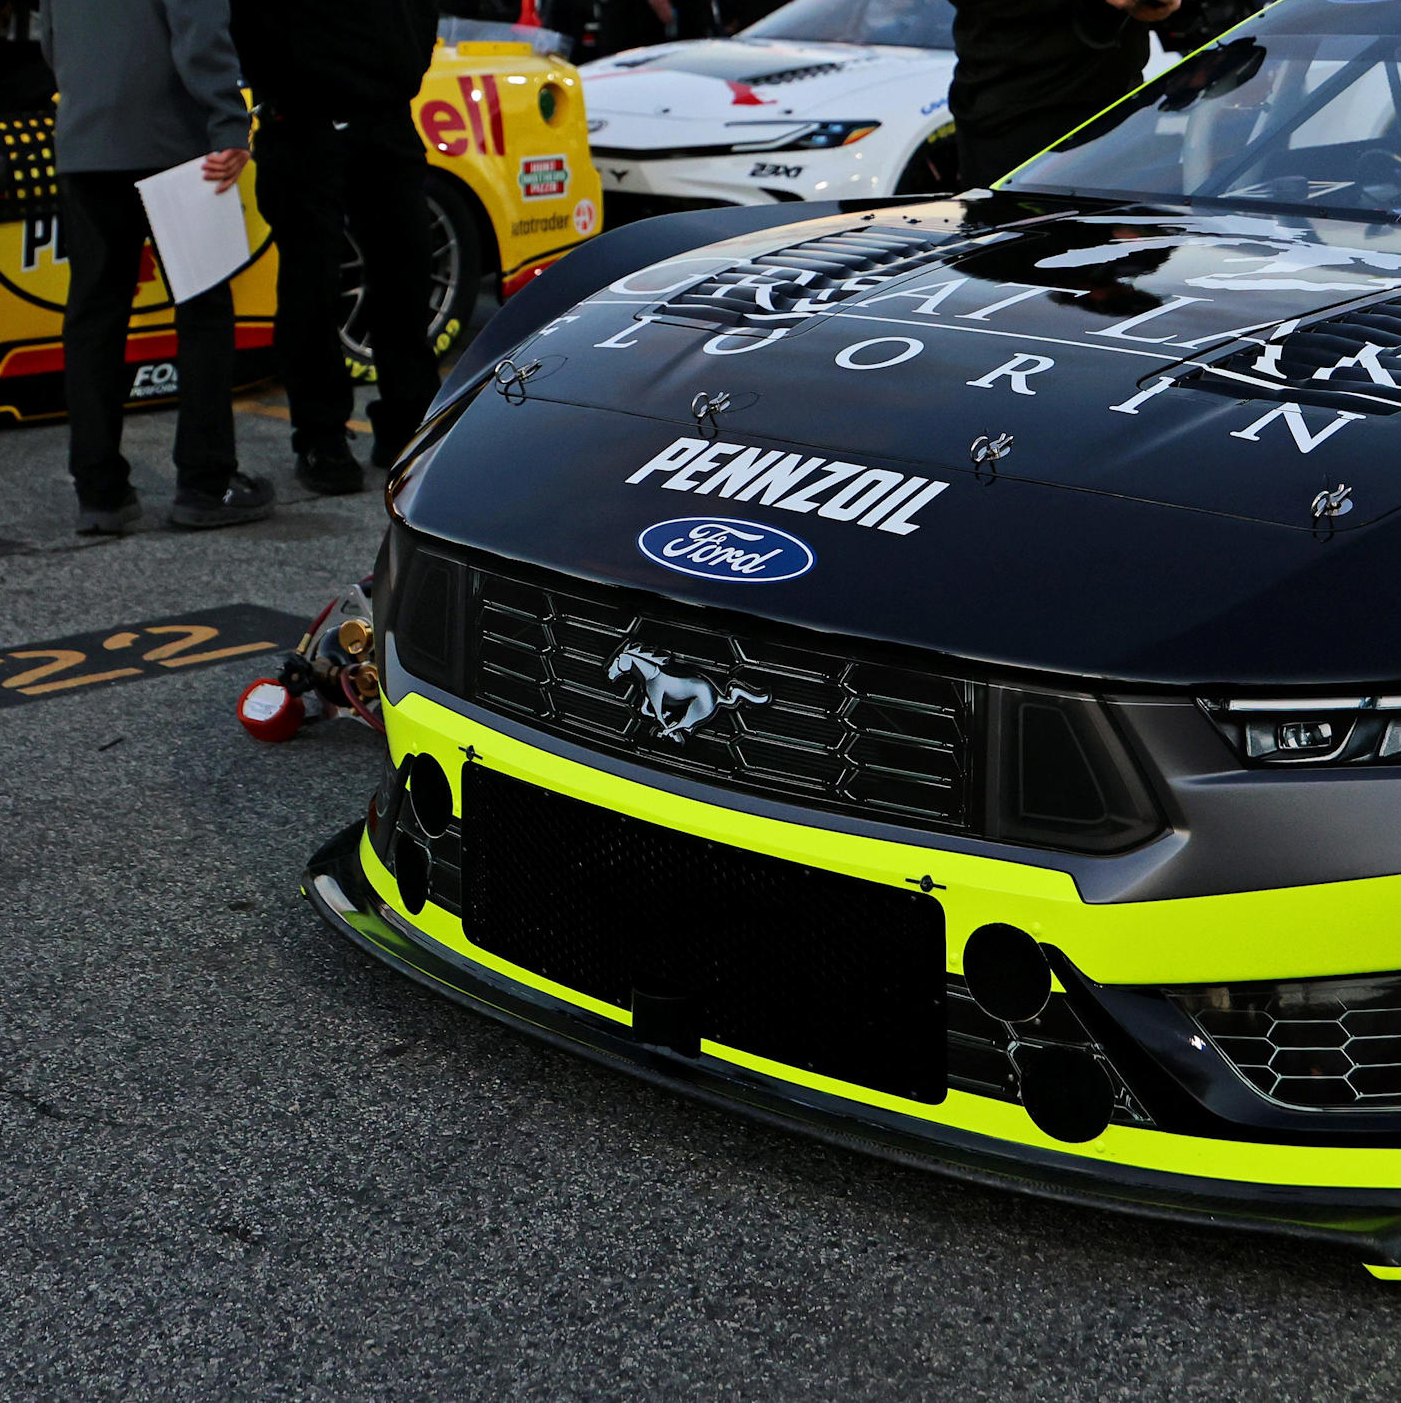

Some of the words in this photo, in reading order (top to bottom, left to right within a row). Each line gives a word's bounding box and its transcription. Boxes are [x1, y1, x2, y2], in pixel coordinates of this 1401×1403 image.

[420, 74, 505, 157] ell
[133, 363, 178, 387] FO
[625, 436, 951, 536] PENNZOIL
[662, 523, 784, 575] Ford
